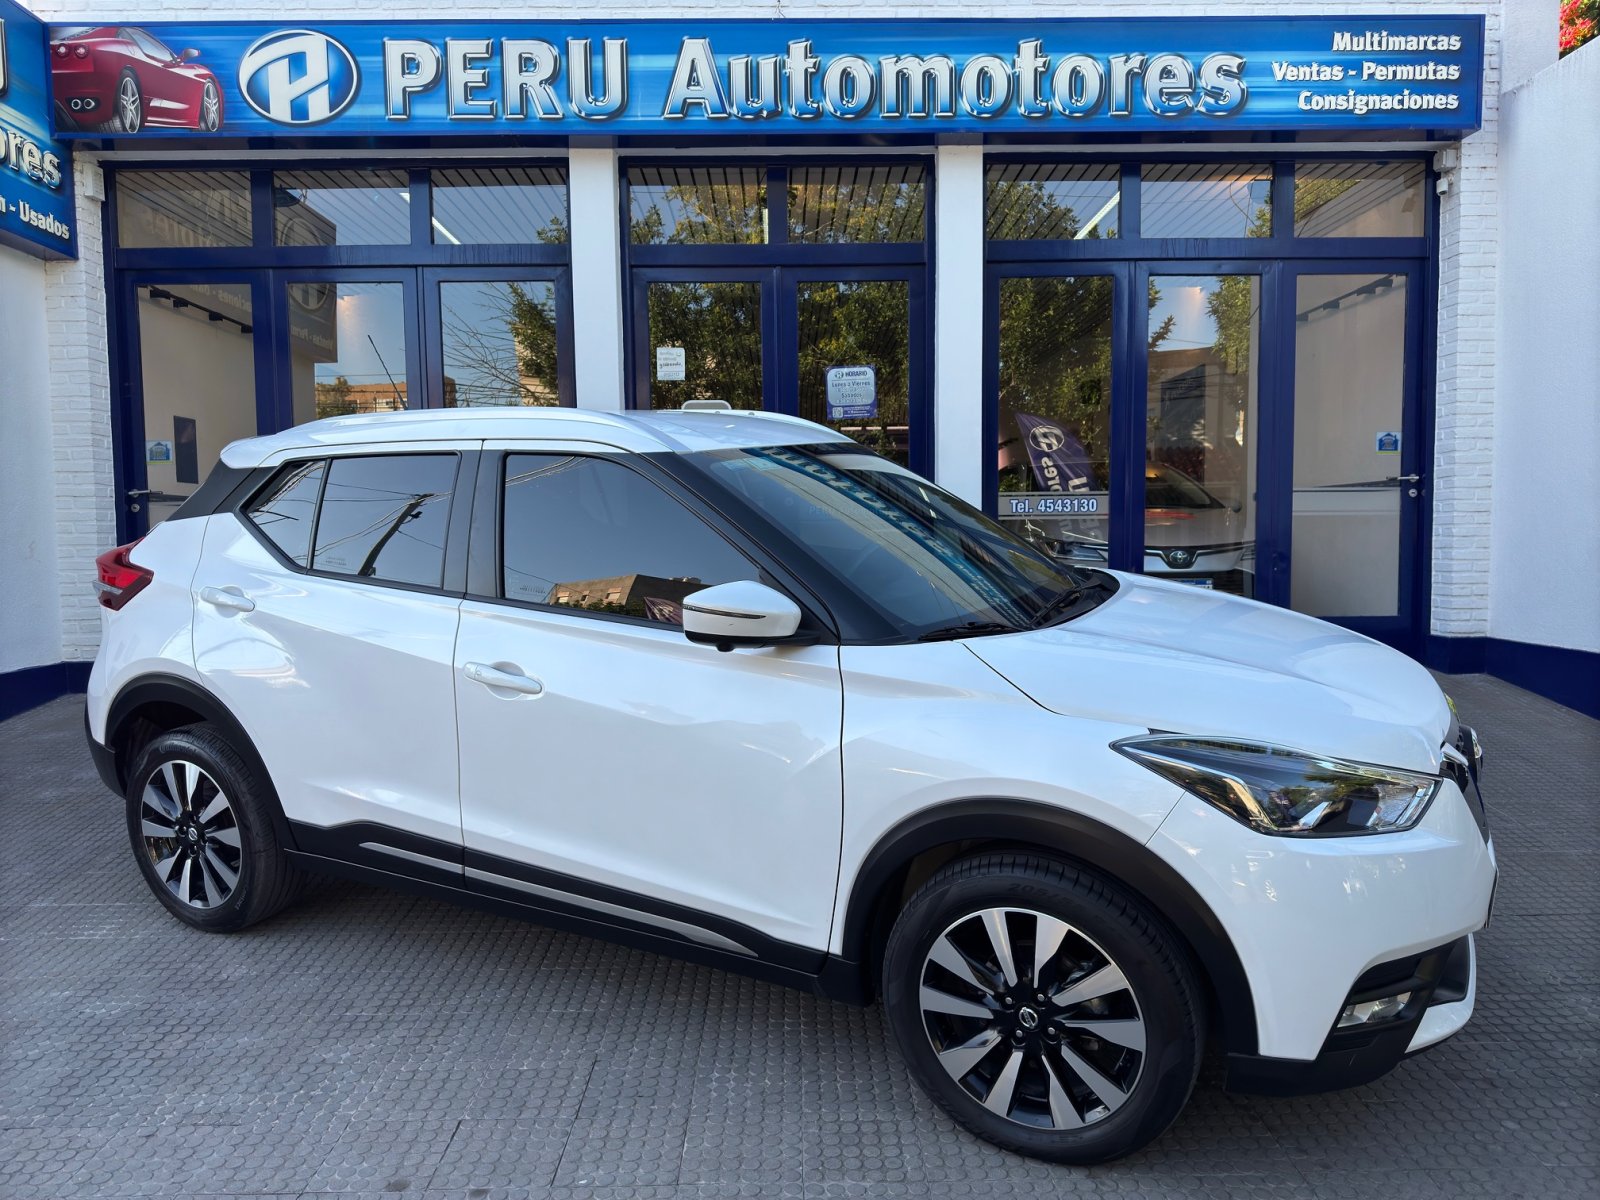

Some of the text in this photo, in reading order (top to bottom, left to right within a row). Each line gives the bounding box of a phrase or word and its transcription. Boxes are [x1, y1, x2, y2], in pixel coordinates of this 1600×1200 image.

[1332, 30, 1461, 51] Multimarcas
[383, 36, 1249, 121] PERU Automotores
[1272, 60, 1344, 81] Ventas
[1362, 60, 1461, 81] Permutas
[1298, 88, 1459, 115] Consignaciones
[19, 199, 70, 240] Usados
[1010, 498, 1097, 513] Tel. 4543130
